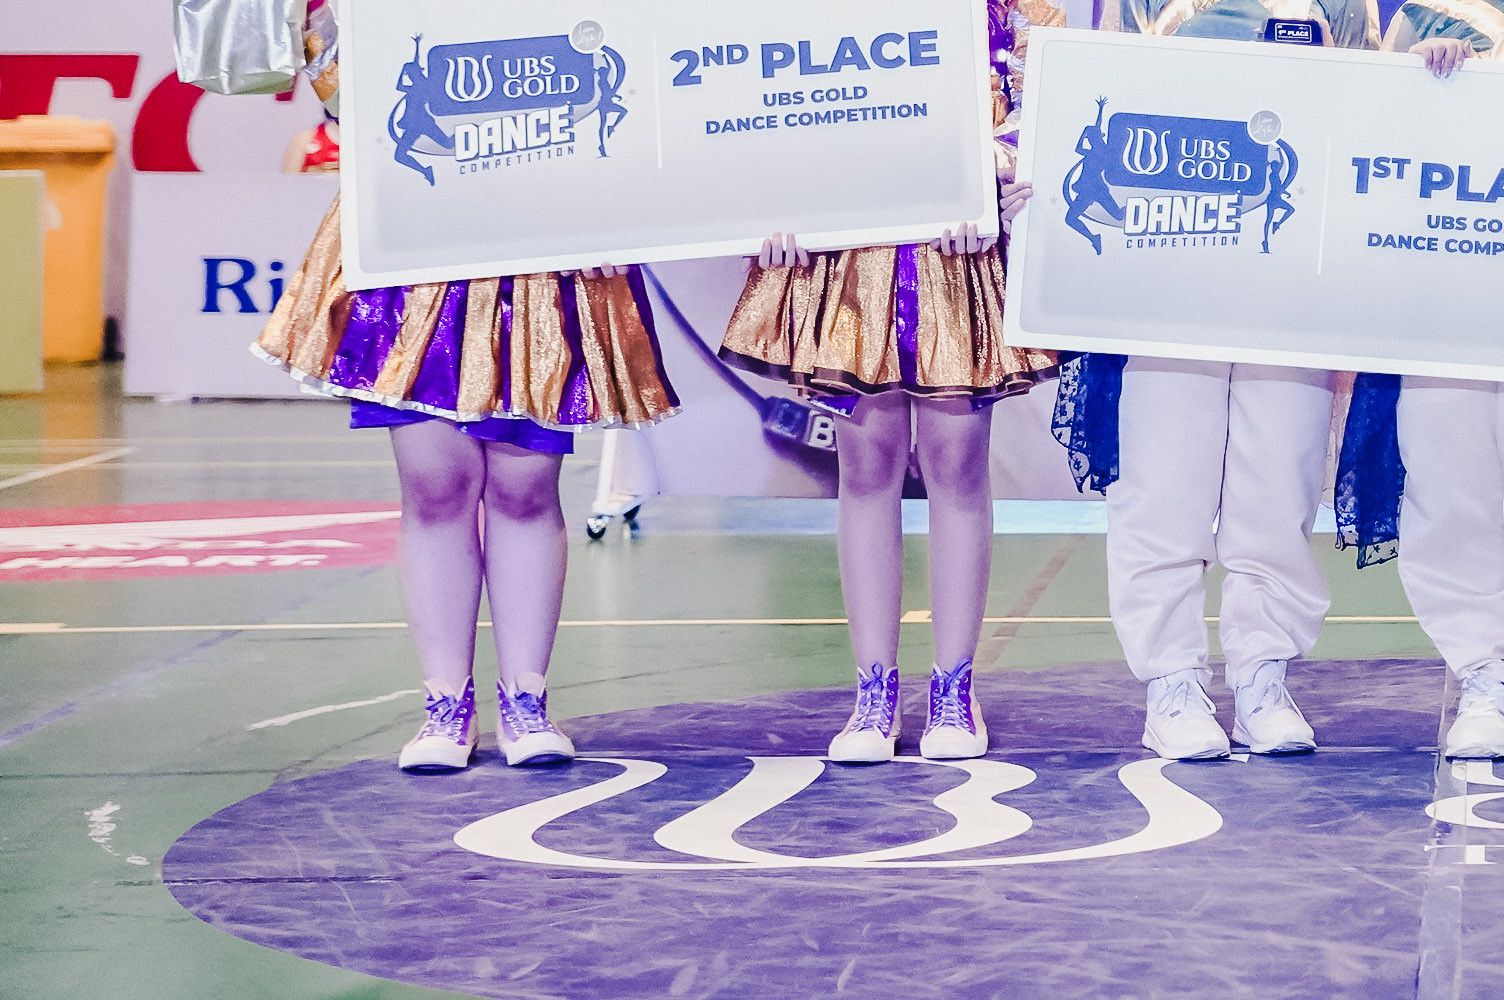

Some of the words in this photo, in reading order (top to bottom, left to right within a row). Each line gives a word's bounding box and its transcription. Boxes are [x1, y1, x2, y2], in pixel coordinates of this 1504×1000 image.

[502, 55, 557, 79] UBS
[669, 43, 749, 87] 2ND
[760, 29, 940, 79] PLACE
[502, 74, 580, 99] GOLD
[763, 90, 805, 107] UBS
[811, 85, 868, 104] GOLD
[705, 115, 778, 135] DANCE
[784, 102, 928, 128] COMPETITION
[455, 102, 575, 162] DANCE
[459, 145, 574, 175] COMPETITION
[1180, 137, 1231, 161] UBS
[1177, 158, 1252, 182] GOLD
[1351, 156, 1411, 194] 1ST
[1124, 193, 1242, 236] DANCE
[1426, 215, 1467, 231] UBS
[1126, 236, 1239, 249] COMPETITION
[1367, 232, 1439, 251] DANCE
[200, 257, 284, 315] Ri
